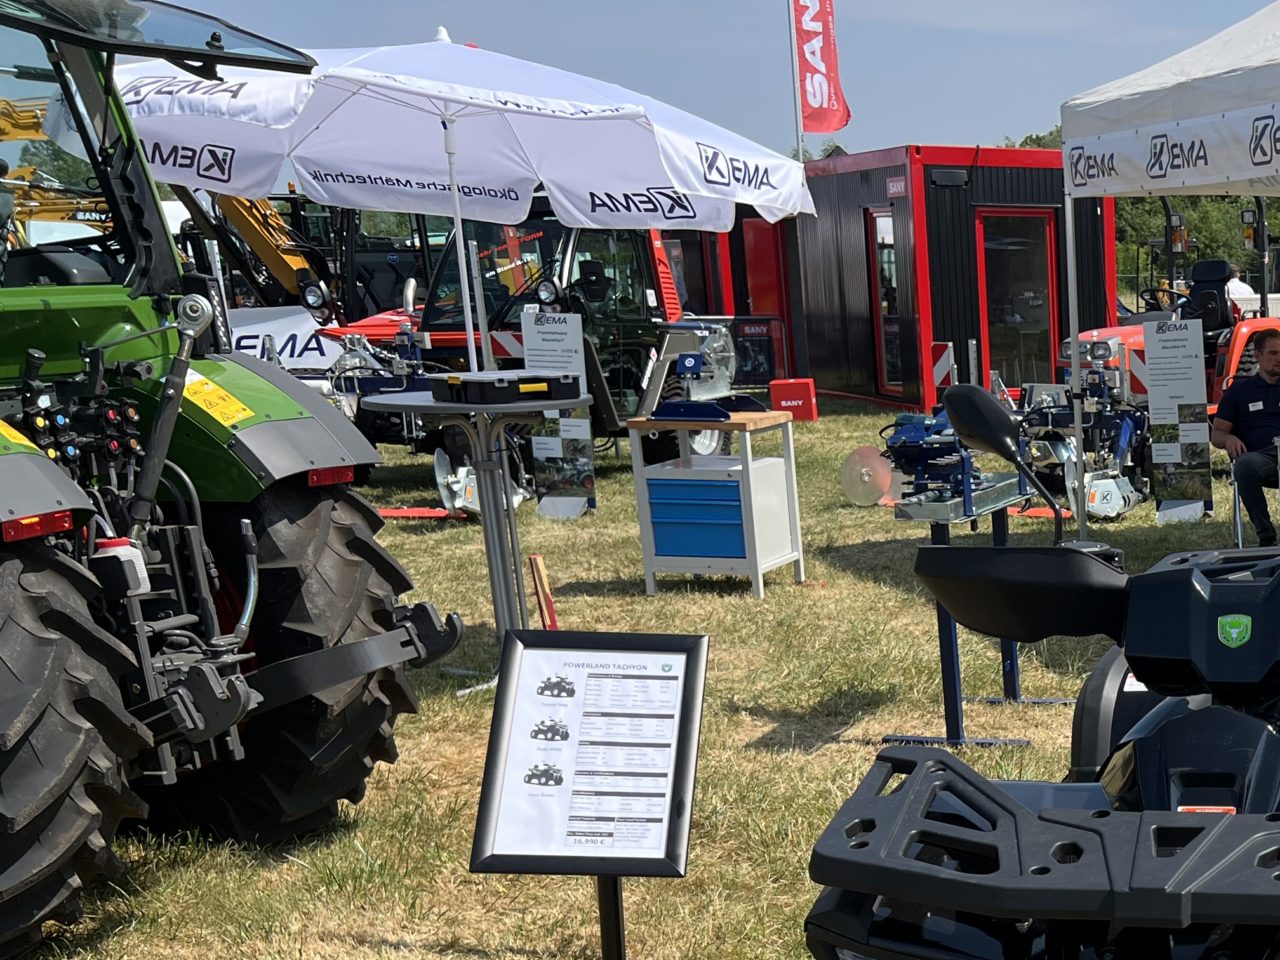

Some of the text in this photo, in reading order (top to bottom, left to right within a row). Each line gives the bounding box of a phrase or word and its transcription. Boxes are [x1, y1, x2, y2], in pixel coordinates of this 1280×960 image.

[120, 78, 249, 104] KEMA
[696, 142, 778, 189] KEMA
[1069, 147, 1119, 187] KEMA
[1147, 134, 1208, 179] KEMA
[534, 314, 567, 326] KEMA
[1156, 322, 1189, 334] KEMA
